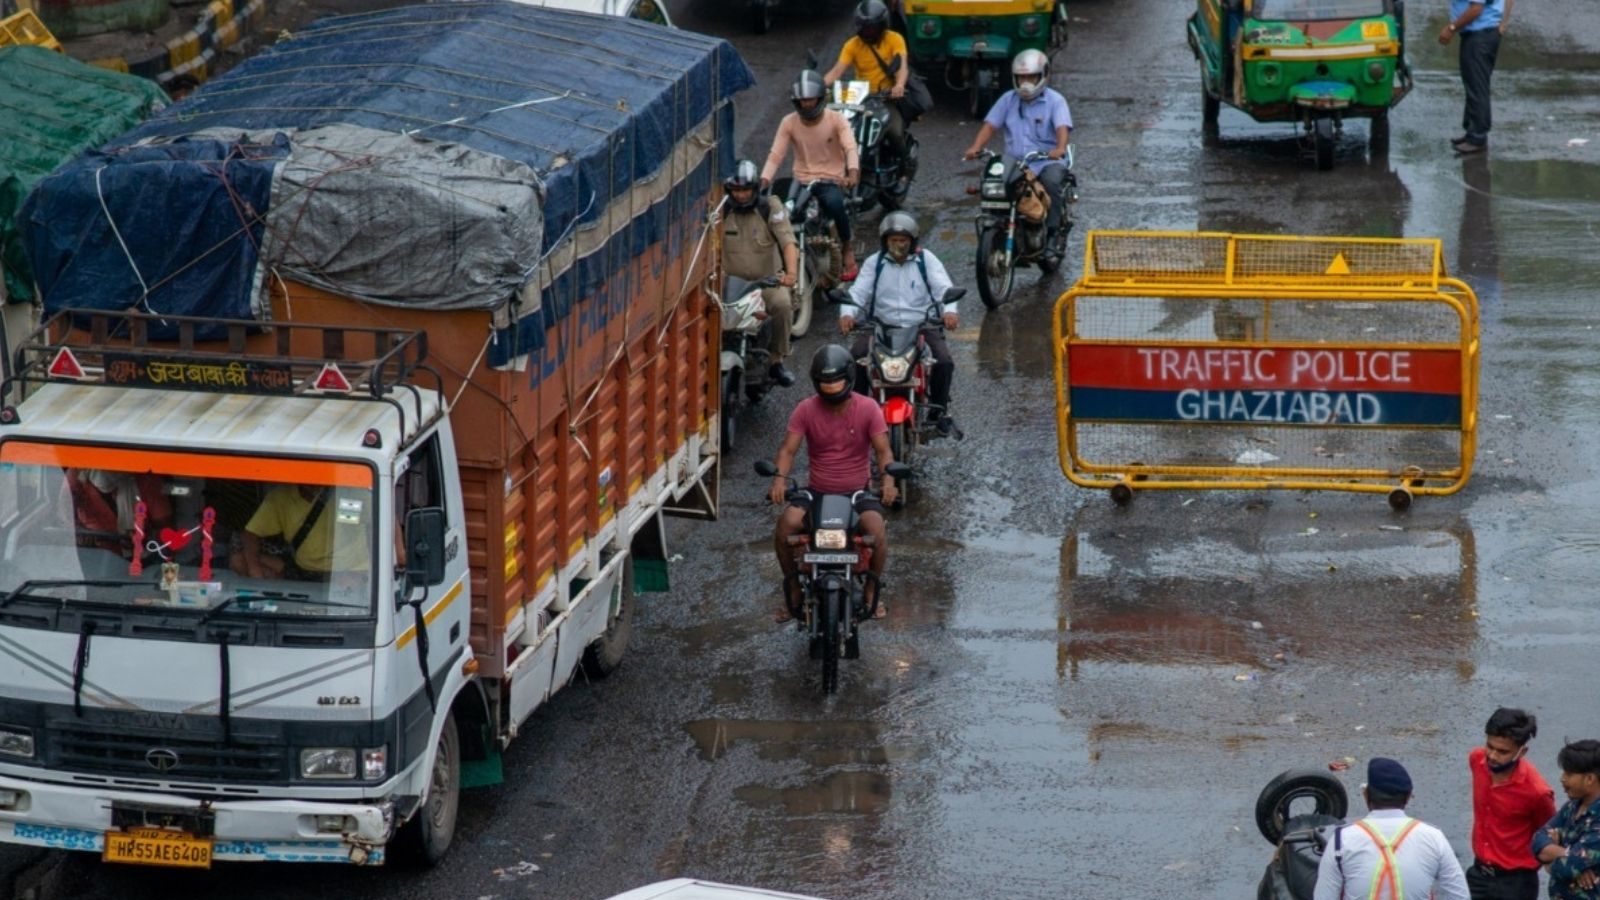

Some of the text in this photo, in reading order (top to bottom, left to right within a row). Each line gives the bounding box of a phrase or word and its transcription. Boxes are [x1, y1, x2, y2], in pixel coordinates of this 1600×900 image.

[1137, 348, 1412, 383] TRAFFIC POLICE
[1175, 388, 1382, 424] GHAZIABAD
